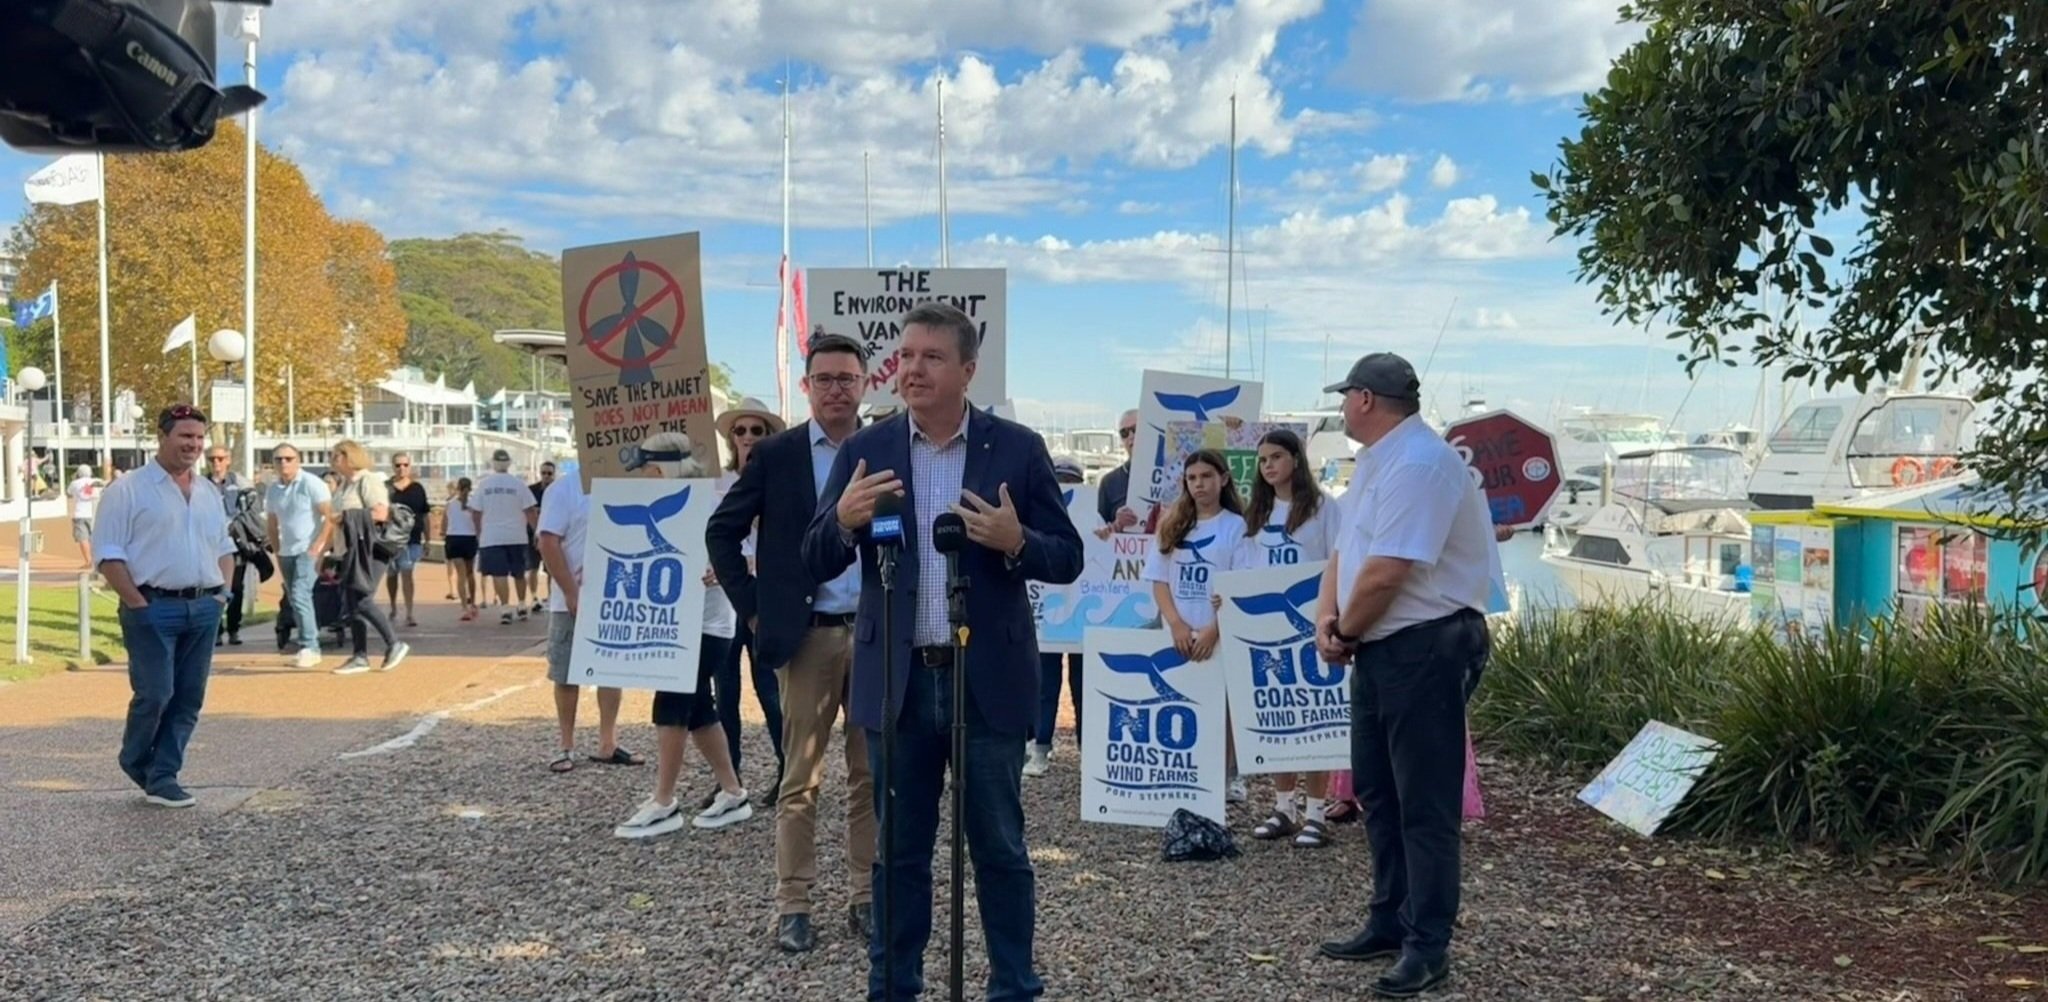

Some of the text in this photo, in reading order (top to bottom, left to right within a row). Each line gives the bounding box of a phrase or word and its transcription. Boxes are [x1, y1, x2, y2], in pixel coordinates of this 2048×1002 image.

[126, 41, 178, 87] Canon
[878, 271, 930, 292] THE
[834, 291, 986, 317] ENVIRONNT
[624, 381, 648, 402] THE
[594, 397, 708, 427] DOES NOT MEAN
[586, 419, 688, 448] DESTROY THE
[1488, 494, 1525, 523] EA
[1114, 537, 1148, 555] NOT
[1269, 548, 1298, 564] NO
[603, 557, 683, 605] NO
[1180, 566, 1208, 583] NO
[600, 600, 679, 625] COASTAL
[597, 624, 679, 641] WIND FARMS
[595, 648, 619, 659] PORT
[1249, 641, 1345, 687] NO
[1253, 687, 1351, 709] COASTAL
[1108, 702, 1197, 750] NO
[1256, 706, 1352, 727] WIND FARMS
[1260, 729, 1347, 745] PORT STEPHEN
[1107, 743, 1198, 769] COASTAL
[1107, 765, 1198, 783] WIND FARMS
[1105, 787, 1197, 800] PORT STEPHENS
